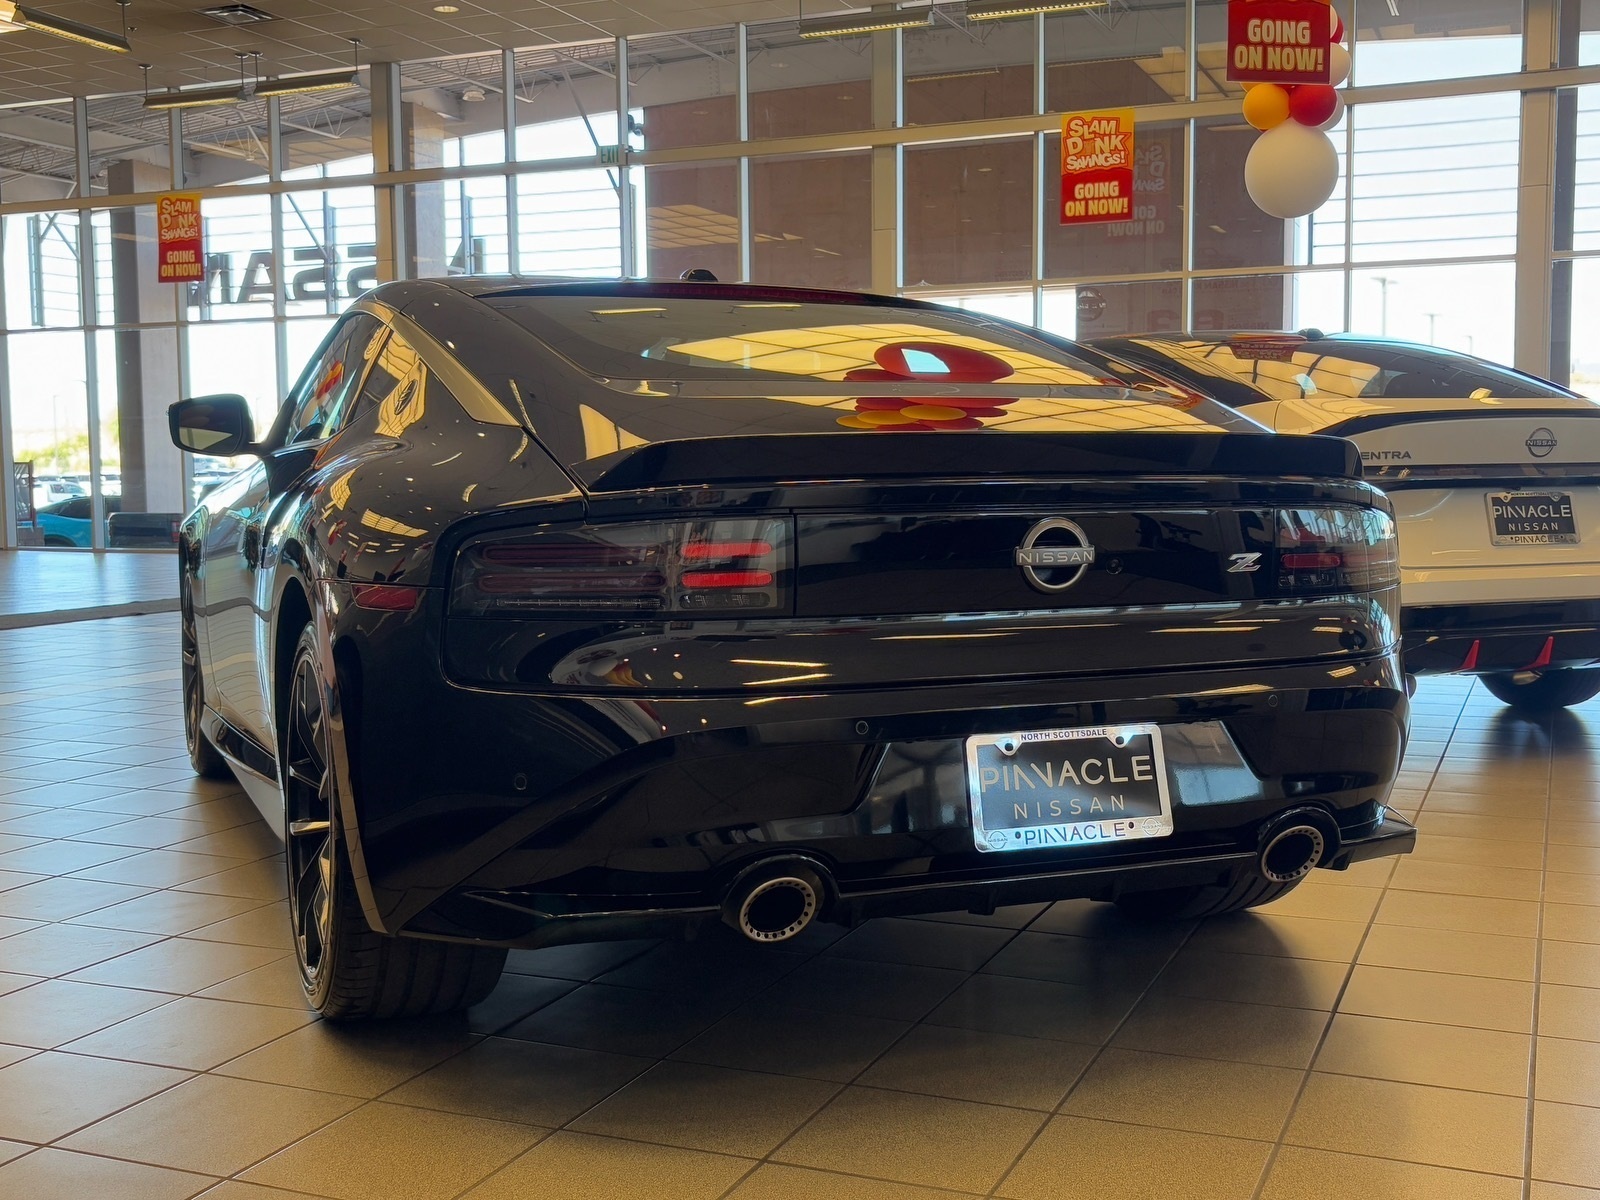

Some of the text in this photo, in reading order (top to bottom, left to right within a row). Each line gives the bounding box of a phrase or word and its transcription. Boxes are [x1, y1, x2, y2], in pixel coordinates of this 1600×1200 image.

[1248, 19, 1311, 44] GOING
[1234, 45, 1323, 72] ON NOW!
[1069, 119, 1117, 139] SLAM
[1066, 134, 1125, 155] DNK
[1066, 151, 1126, 170] SAVINGS!
[1074, 181, 1119, 199] GOING
[161, 199, 192, 217] SLAM
[1064, 197, 1128, 217] ON NOW!
[160, 213, 197, 228] DNK
[166, 250, 196, 264] GOING
[161, 263, 202, 277] ON NOW!
[1360, 450, 1412, 460] ENTRA
[1492, 504, 1572, 518] PINNACLE
[1508, 522, 1559, 531] NISSAN
[1019, 550, 1094, 564] NISSAN
[1226, 552, 1263, 573] Z
[1020, 728, 1108, 741] NORTH SCOTTSDALE
[979, 755, 1154, 793] PINNACLE
[1013, 794, 1126, 820] NISSAN
[1024, 822, 1126, 845] PINNACLE
